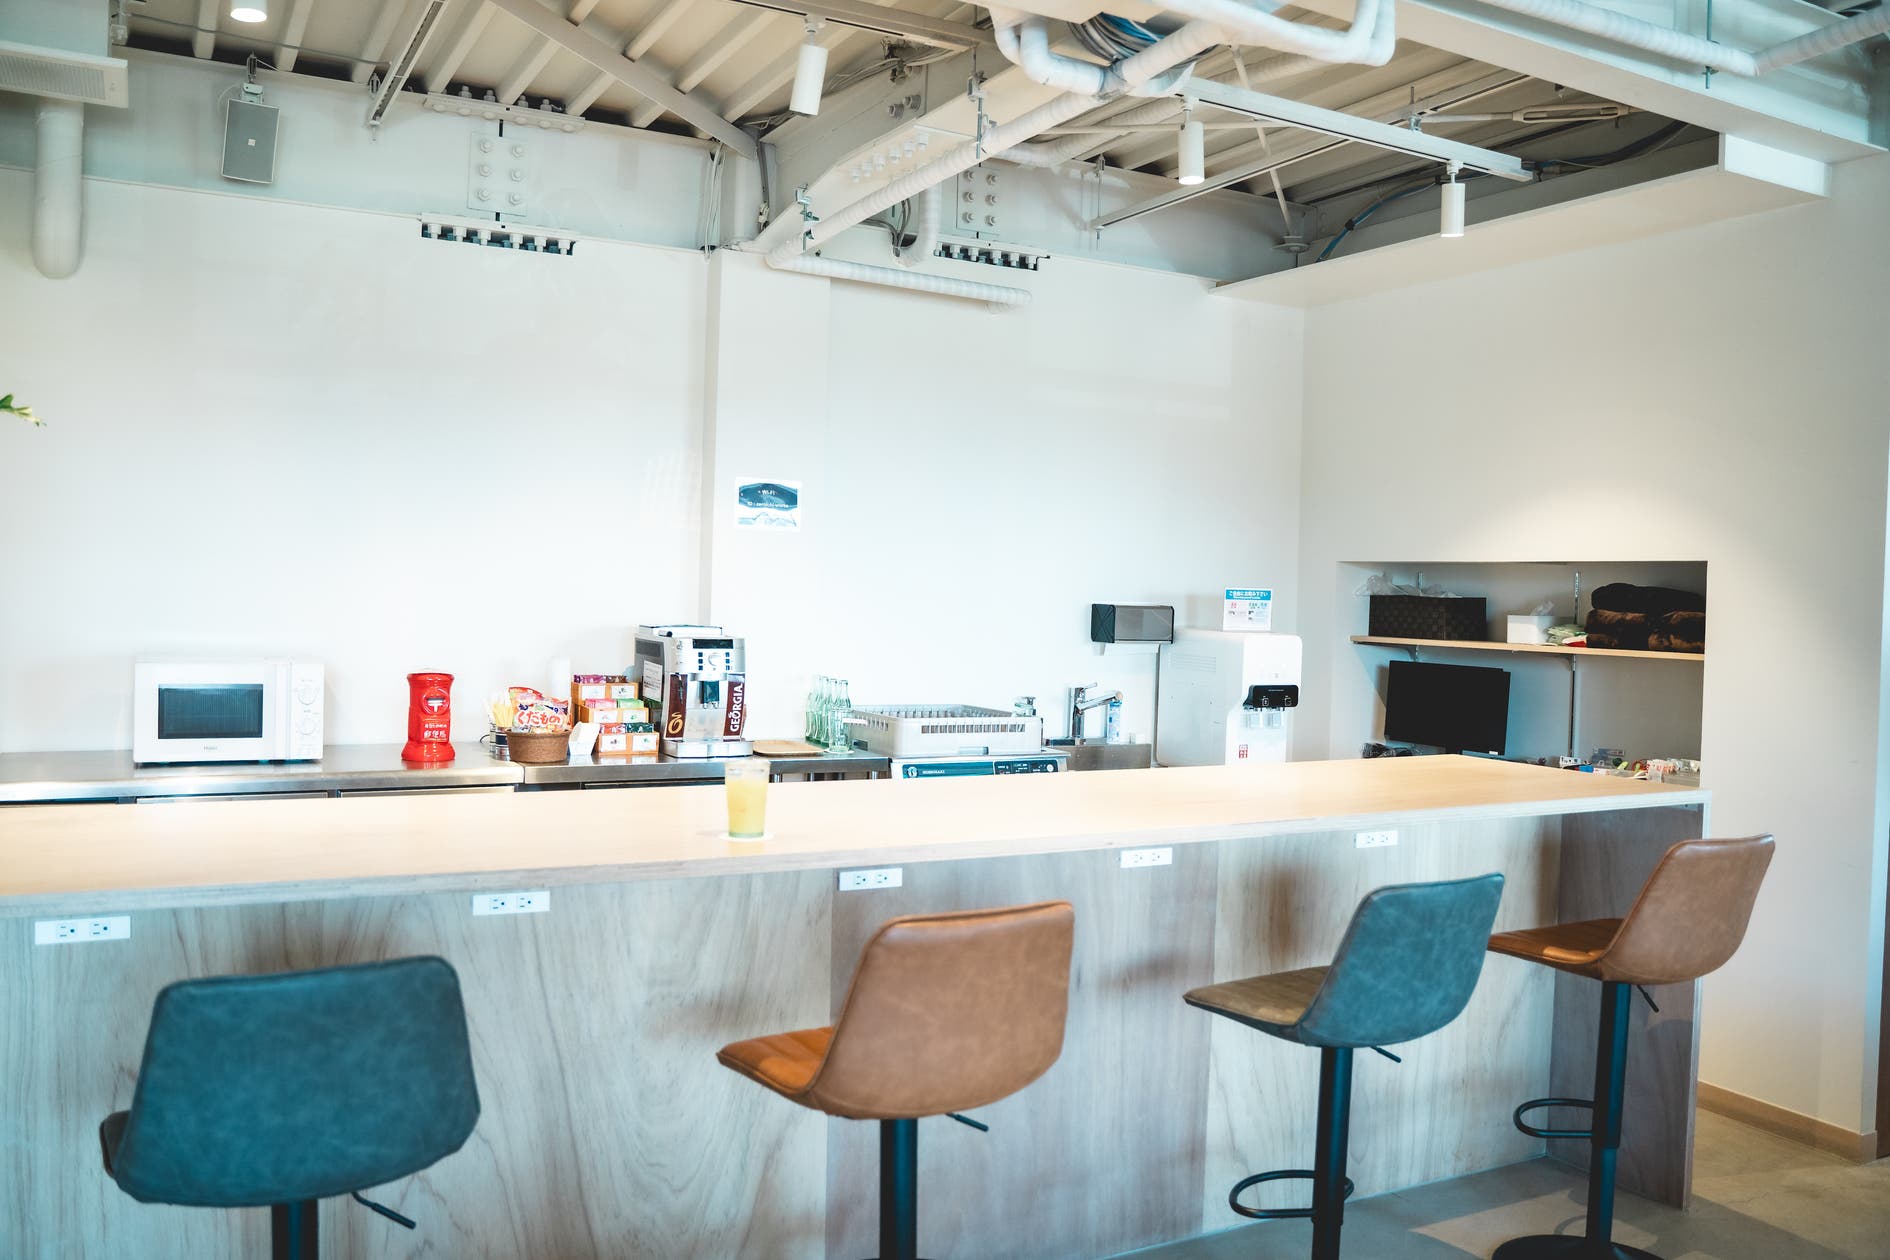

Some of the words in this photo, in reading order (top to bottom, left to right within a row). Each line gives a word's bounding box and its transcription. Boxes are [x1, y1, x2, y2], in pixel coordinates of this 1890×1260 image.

[517, 711, 561, 725] くだもの
[728, 683, 743, 732] GEORGIA
